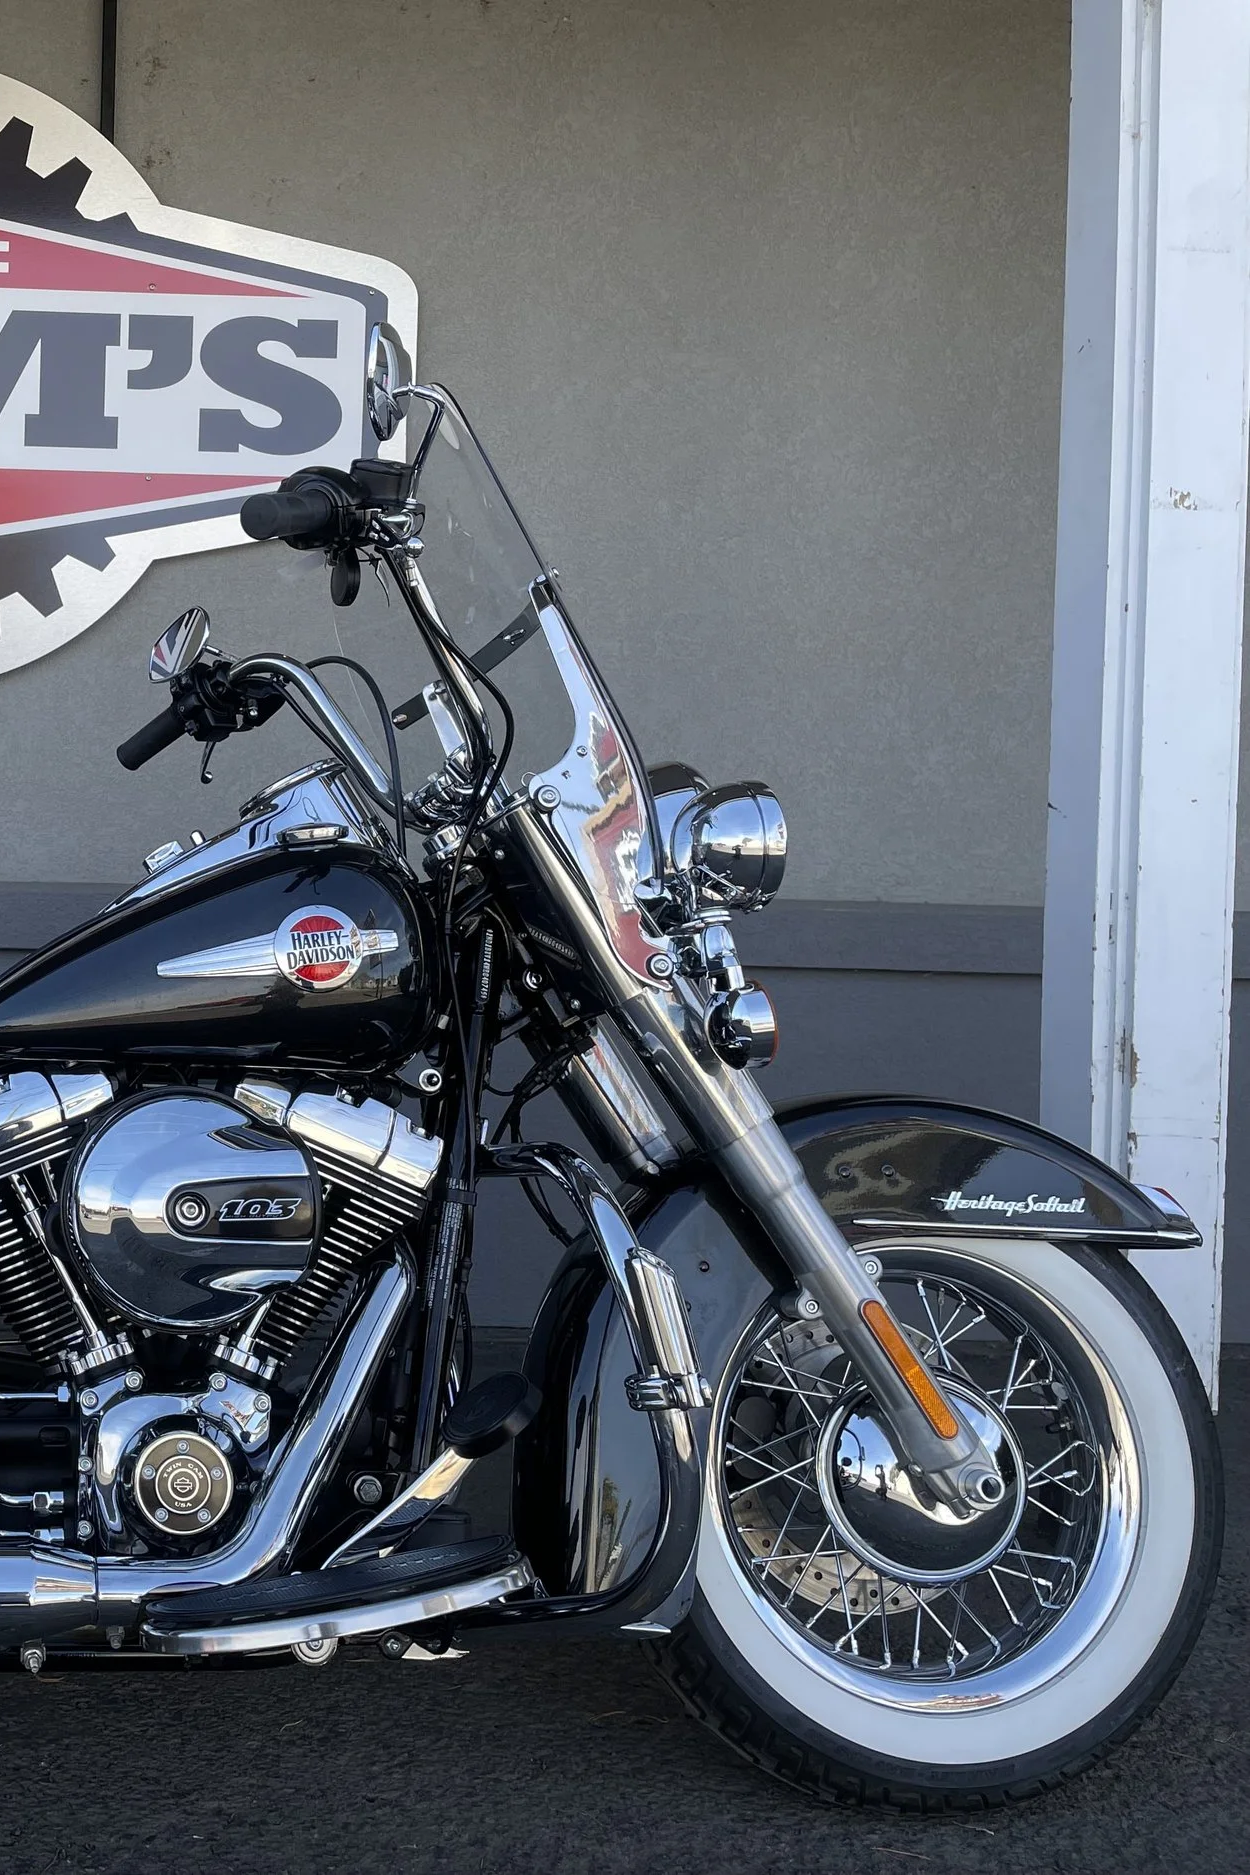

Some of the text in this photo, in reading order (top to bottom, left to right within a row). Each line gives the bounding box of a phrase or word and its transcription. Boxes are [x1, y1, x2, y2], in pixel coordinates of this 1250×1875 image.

[291, 930, 349, 951] HARLEY-
[286, 945, 355, 969] DAVIDSON
[218, 1198, 302, 1222] 103
[930, 1190, 1086, 1217] Heritage Softail
[162, 1462, 204, 1479] TWIN CAM
